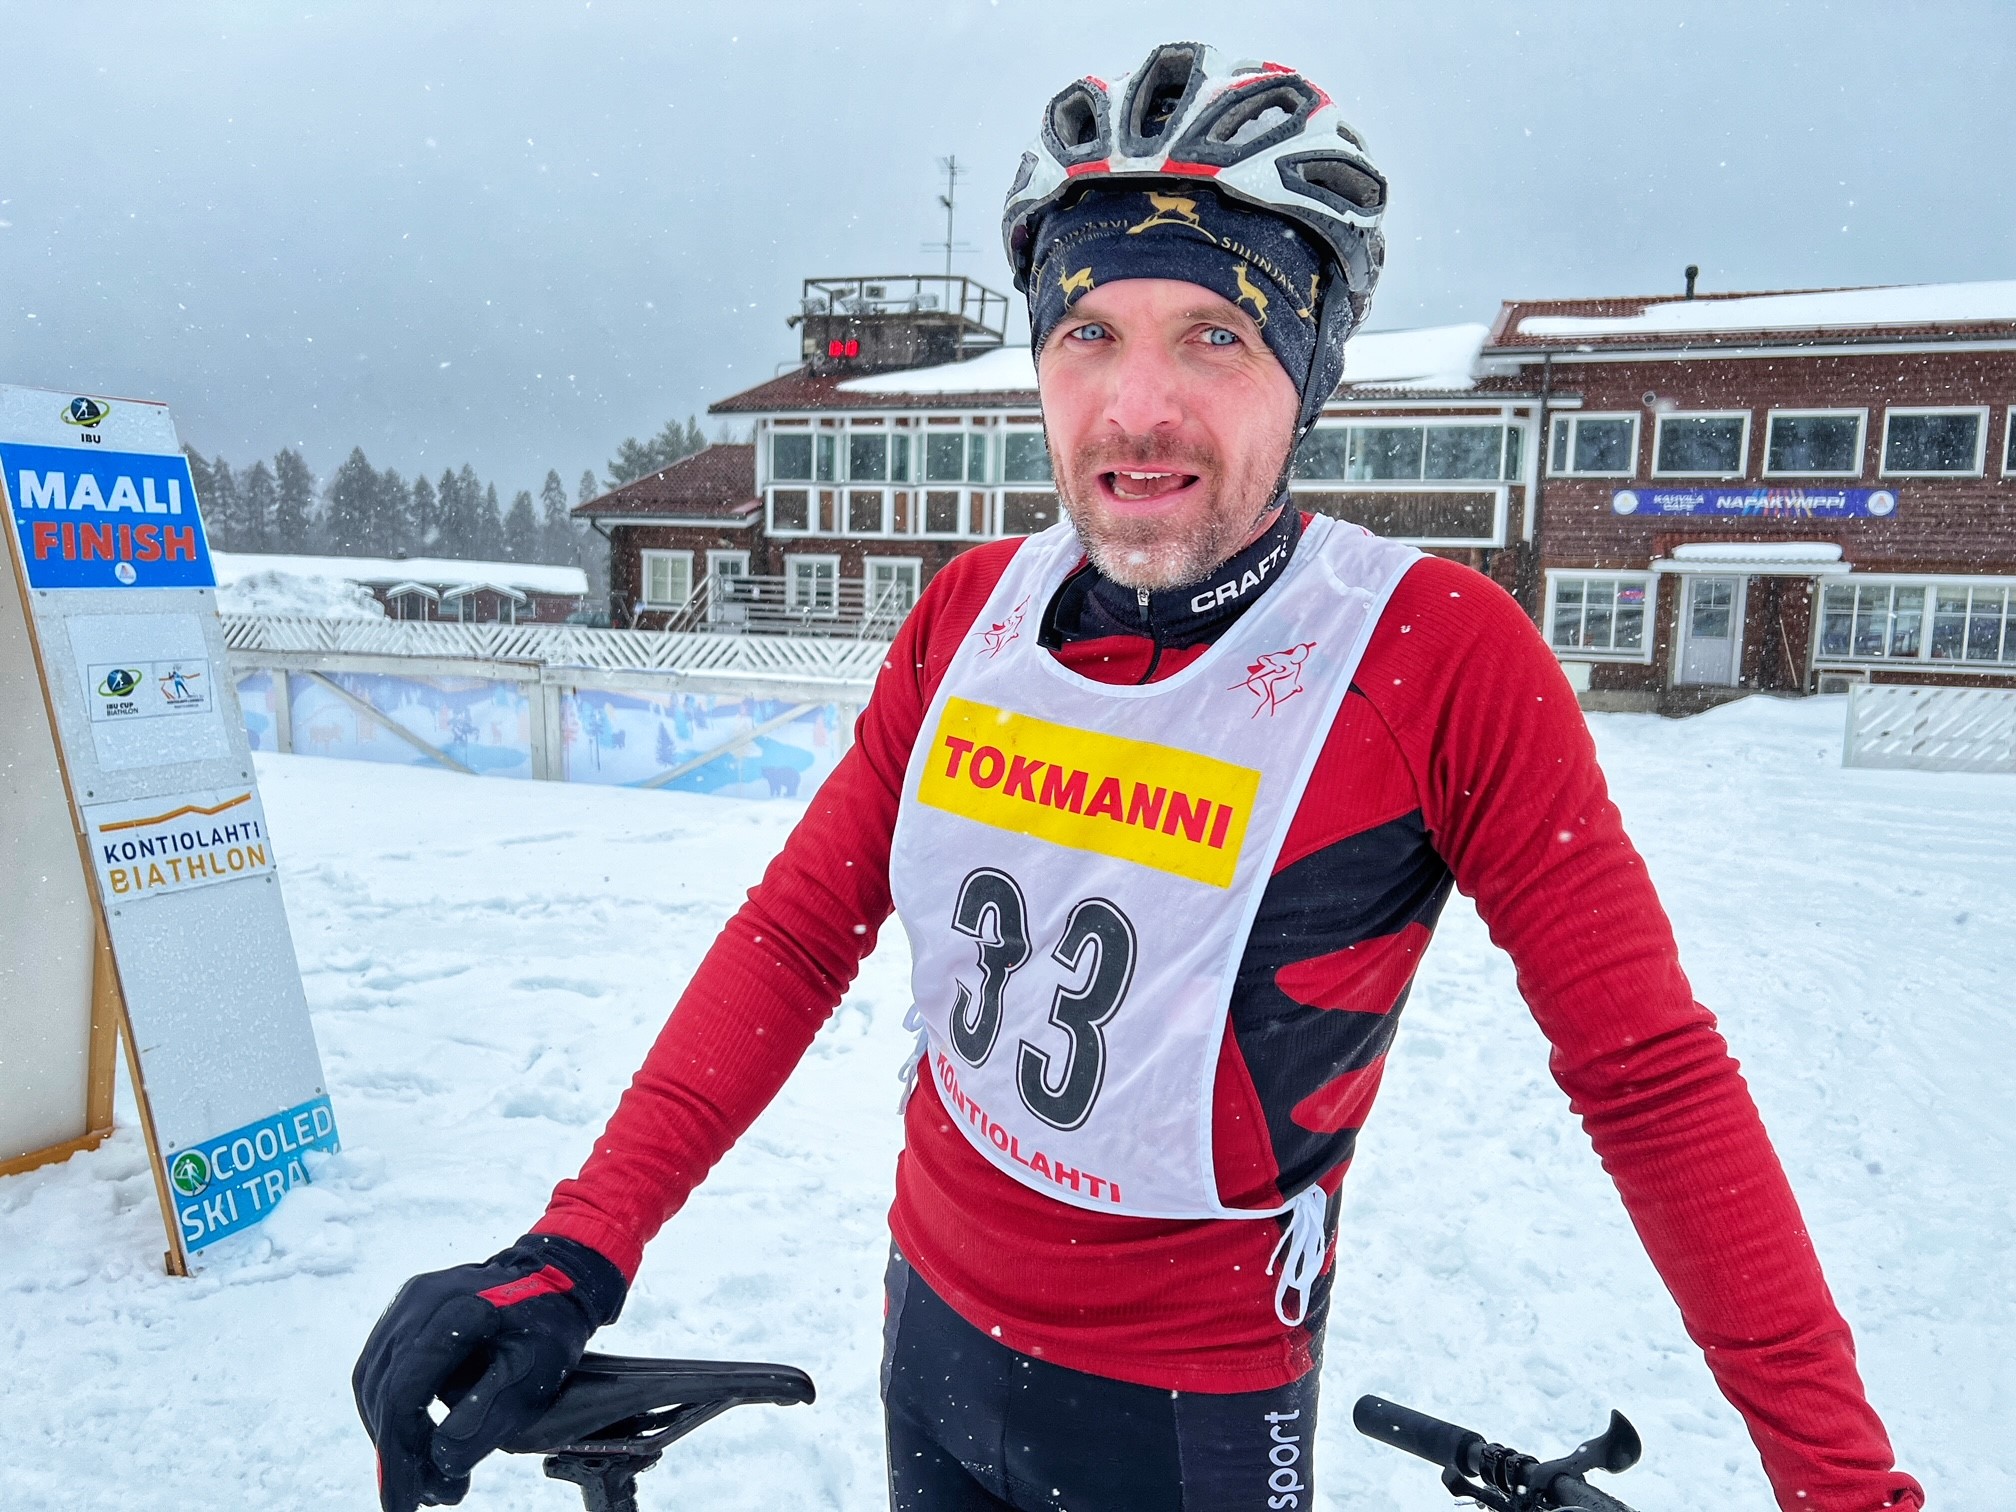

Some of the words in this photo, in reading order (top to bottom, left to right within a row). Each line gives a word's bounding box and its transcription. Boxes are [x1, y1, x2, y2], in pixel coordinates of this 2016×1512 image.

[81, 433, 101, 444] IBU
[19, 469, 182, 515] MAALI
[32, 522, 196, 562] FINISH
[1190, 544, 1282, 613] CRAFT
[943, 734, 1233, 850] TOKMANNI
[103, 820, 261, 864] KONTIOLAHTI
[109, 843, 267, 894] BIATHLON
[949, 866, 1138, 1132] 33
[210, 1104, 334, 1181] COOLED
[936, 1050, 1121, 1204] KONTIOLAHTI
[181, 1189, 239, 1242] SKI
[1263, 1409, 1305, 1510] sport
